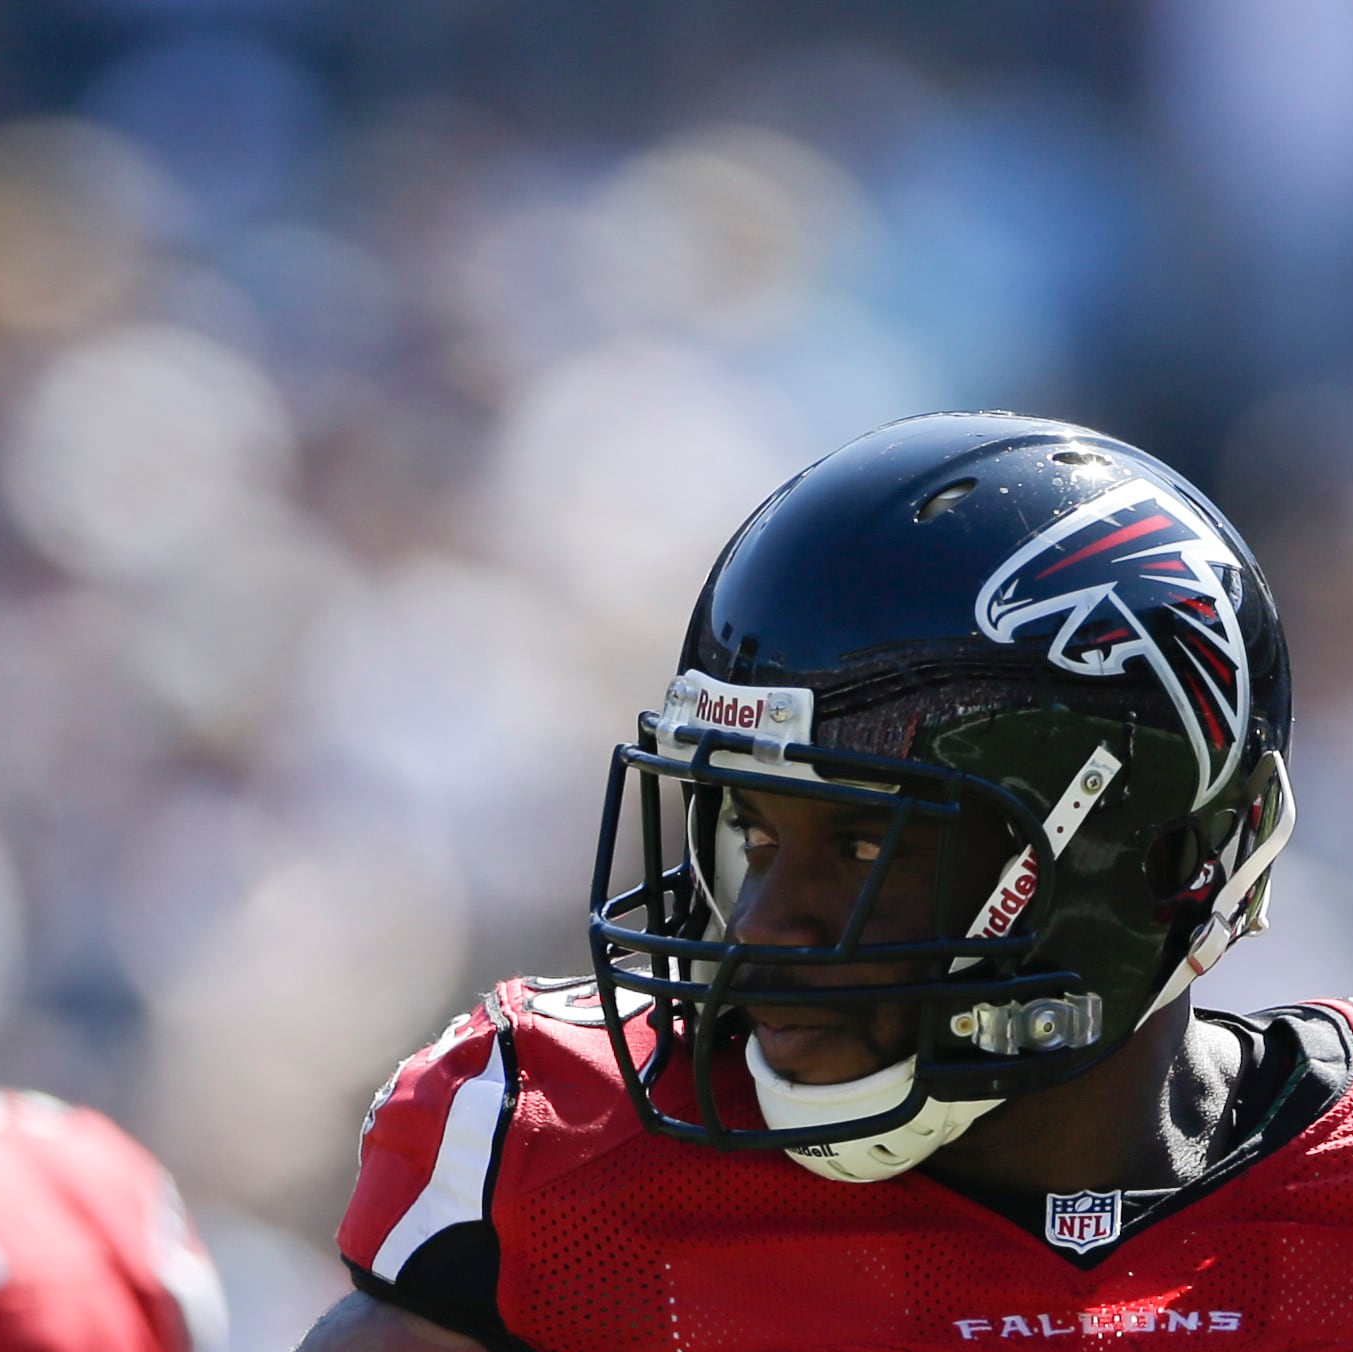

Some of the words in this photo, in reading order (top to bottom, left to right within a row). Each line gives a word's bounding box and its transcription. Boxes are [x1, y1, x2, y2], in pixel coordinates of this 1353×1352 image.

[697, 688, 767, 729] Riddel
[1057, 1215, 1107, 1241] NFL
[953, 1309, 1243, 1340] FALCONS
